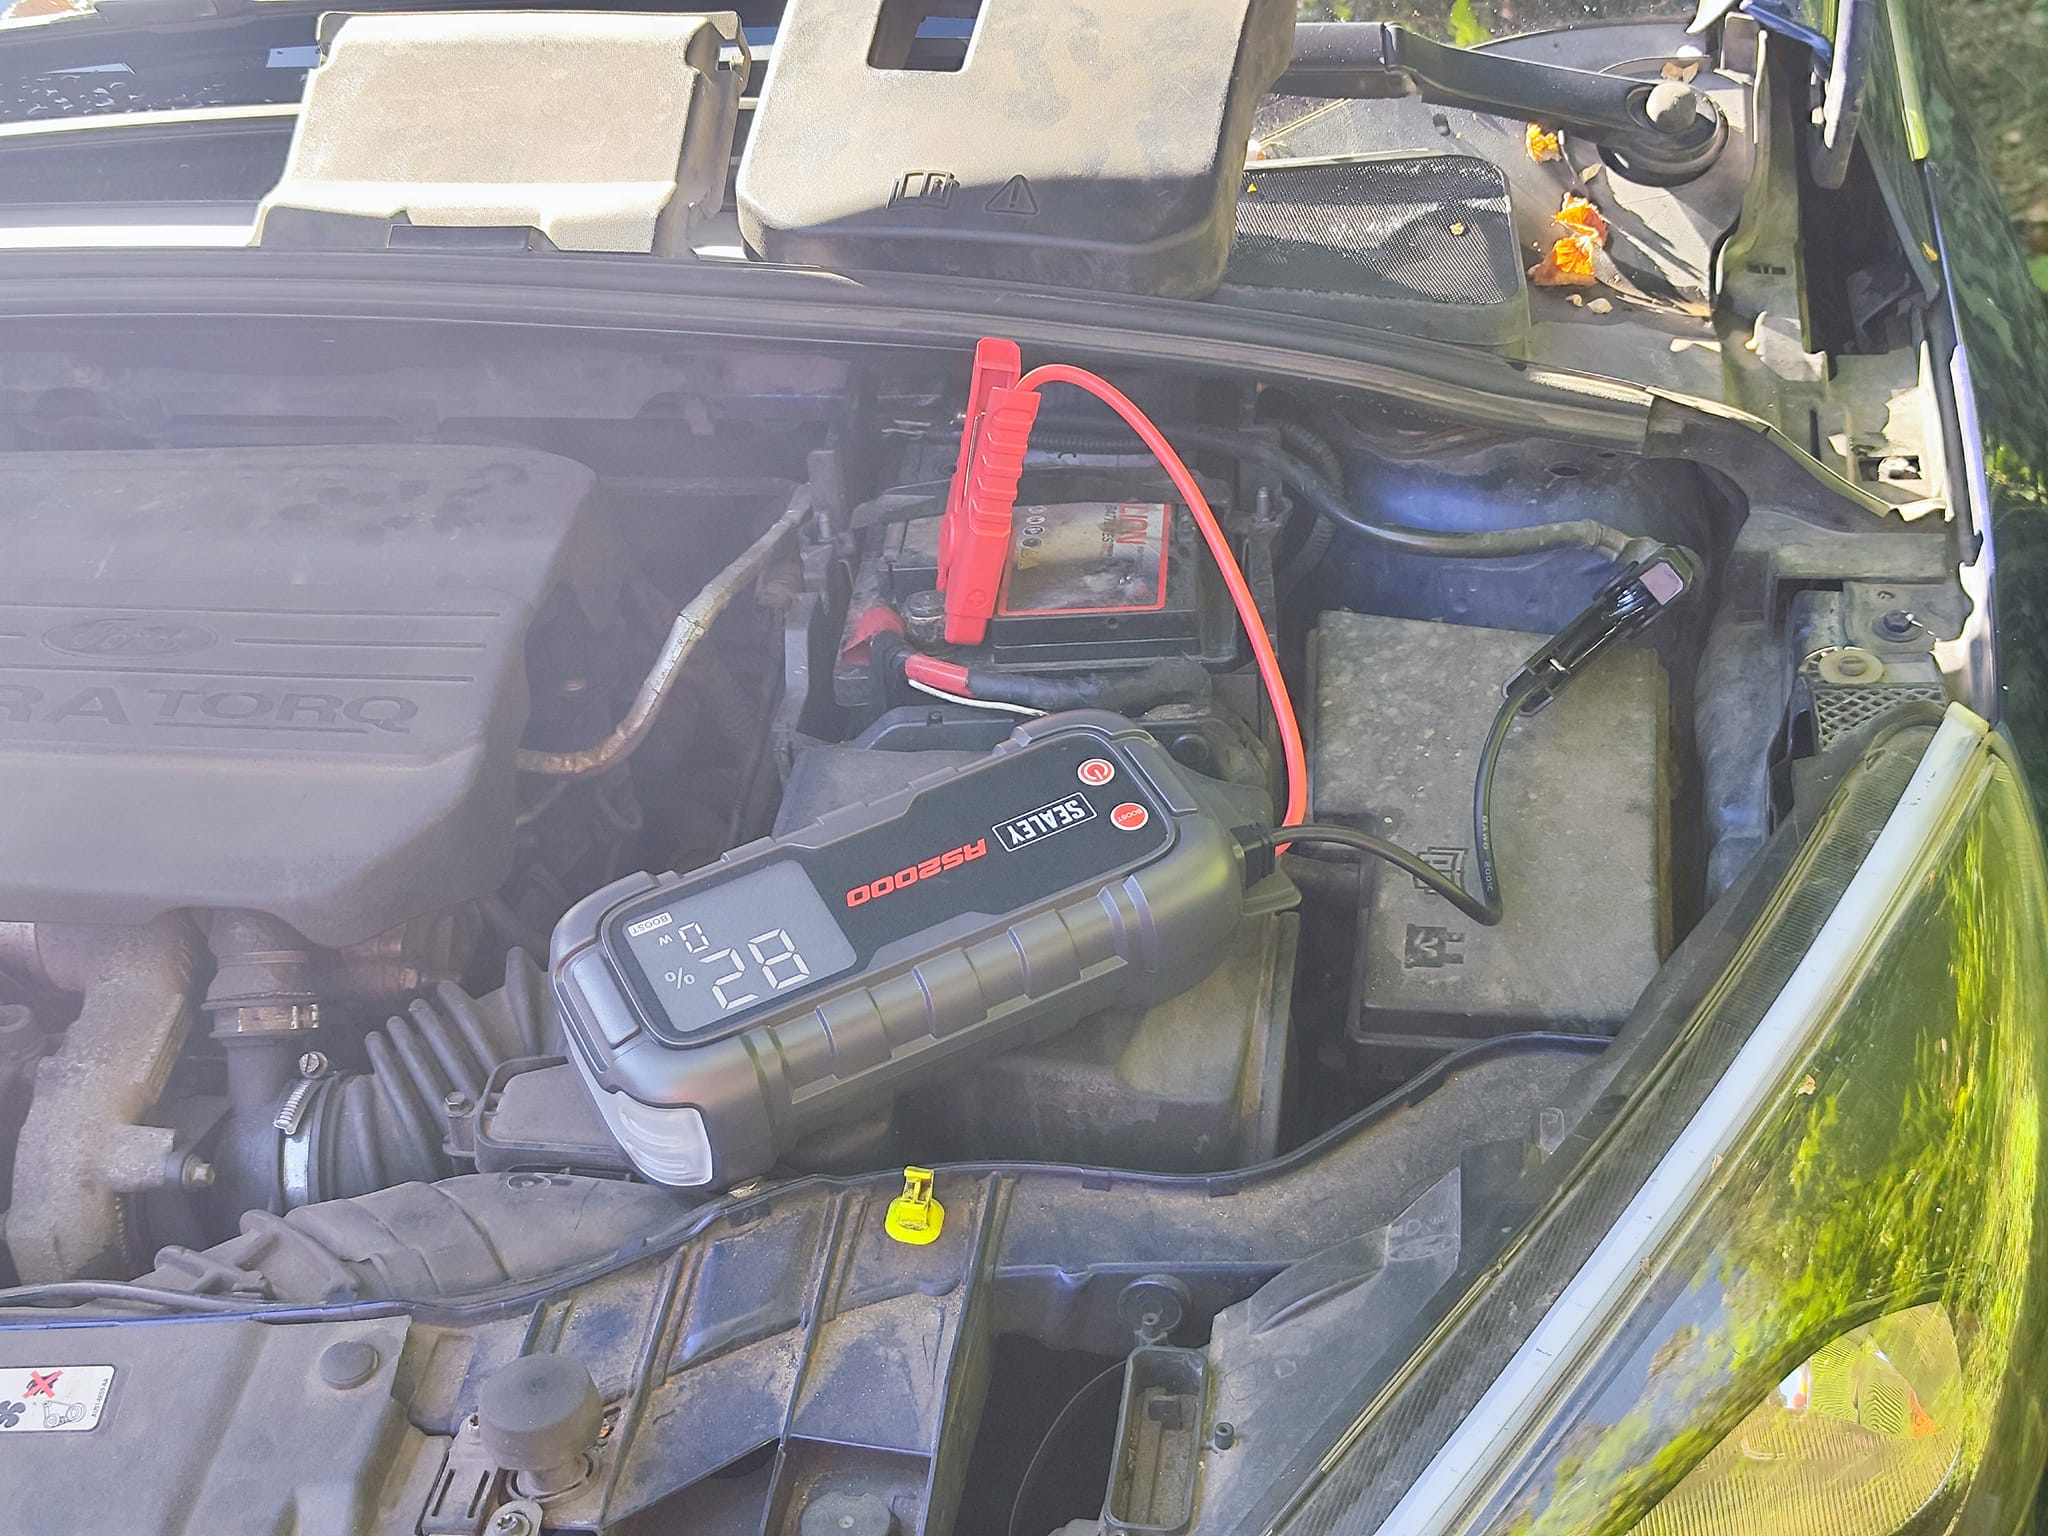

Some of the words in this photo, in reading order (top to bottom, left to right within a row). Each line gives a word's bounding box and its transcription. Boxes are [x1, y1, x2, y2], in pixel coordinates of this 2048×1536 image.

[1006, 799, 1086, 845] SEALEY
[1117, 808, 1143, 822] BOOST
[846, 838, 988, 908] RS2000
[631, 914, 669, 935] BOOST
